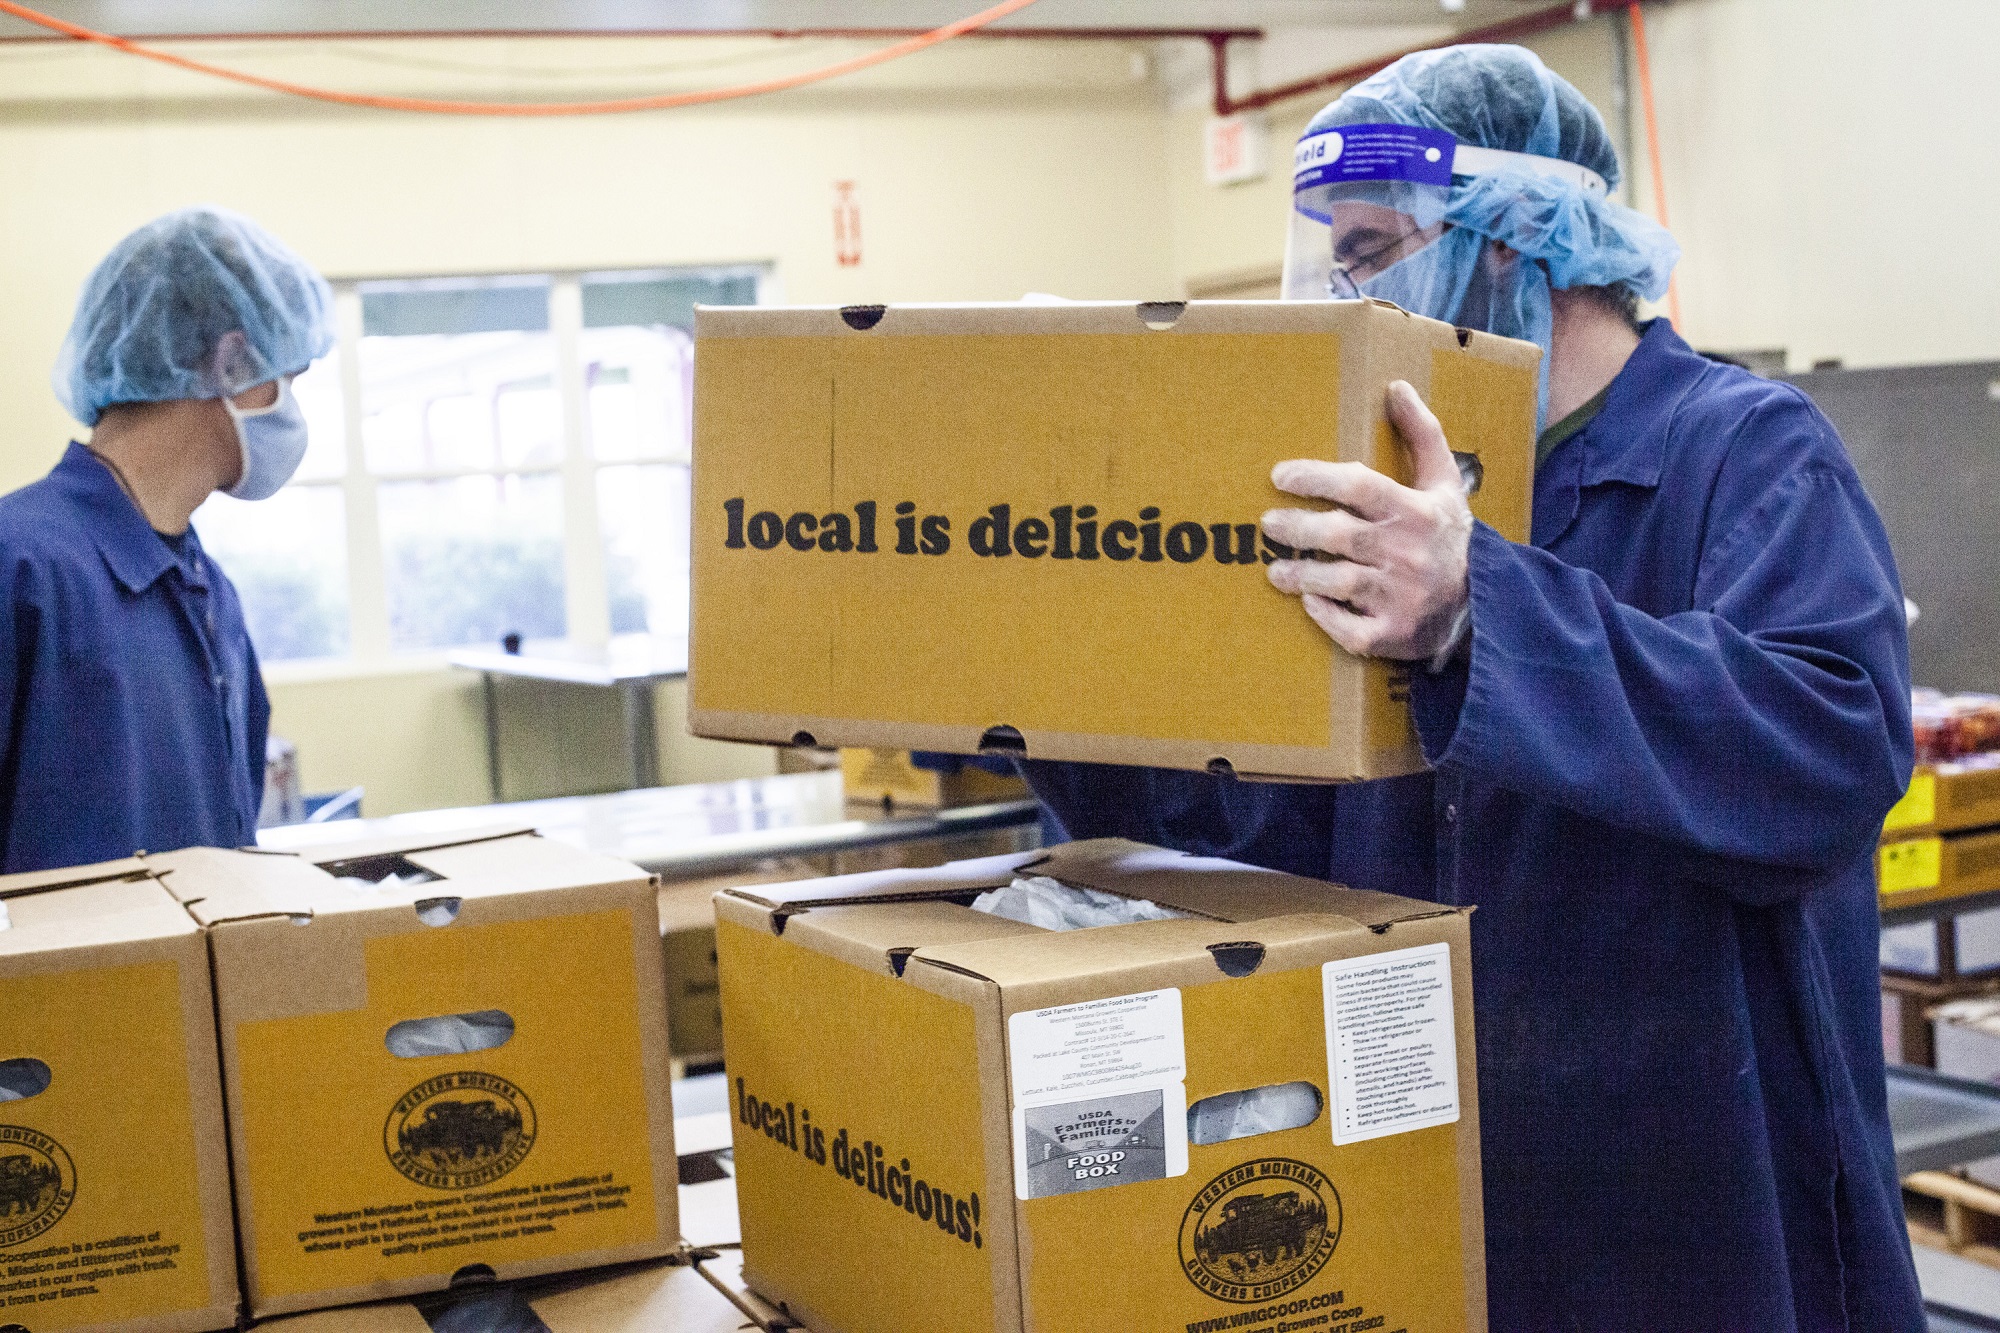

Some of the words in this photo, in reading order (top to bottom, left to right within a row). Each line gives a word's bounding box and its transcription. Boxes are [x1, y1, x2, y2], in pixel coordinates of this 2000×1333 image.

[724, 497, 878, 554] local
[895, 501, 951, 556] is
[968, 504, 1315, 566] deliciou
[1353, 967, 1388, 978] Handling
[1390, 959, 1435, 971] Instructions
[1371, 975, 1398, 984] products
[1374, 991, 1398, 999] product
[1406, 983, 1442, 993] mishandled
[1053, 1006, 1076, 1014] Farmers
[1085, 1001, 1107, 1009] Families
[1135, 993, 1158, 1003] Program
[1344, 1004, 1367, 1012] cooked
[1338, 1022, 1364, 1030] handling
[1369, 1022, 1406, 1033] refrigerated
[1378, 1029, 1414, 1040] refrigerator
[1410, 1042, 1431, 1050] poultry
[1354, 1060, 1381, 1069] separate
[1374, 1065, 1398, 1074] working
[1400, 1060, 1425, 1068] surfaces
[1387, 1071, 1407, 1079] cutting
[1356, 1092, 1383, 1102] touching
[1078, 1110, 1112, 1120] USDA
[1358, 1115, 1392, 1127] Refrigerate
[1394, 1109, 1420, 1118] leftovers
[1430, 1103, 1452, 1111] discard
[1054, 1116, 1122, 1134] Farmers
[0, 1128, 54, 1155] ONTANA
[1058, 1126, 1129, 1143] Families
[736, 1077, 798, 1151] local
[802, 1109, 826, 1166] is
[832, 1128, 982, 1249] delicious!
[1067, 1151, 1126, 1169] FOOD
[1075, 1164, 1119, 1180] BOX
[1193, 1165, 1255, 1213] WESTERN
[1260, 1162, 1323, 1191] MONTANA
[0, 1245, 69, 1264] Cooperative
[71, 1243, 82, 1252] is
[94, 1235, 144, 1249] coalition
[147, 1232, 160, 1242] of
[1187, 1259, 1247, 1299] GROWERS
[1253, 1230, 1337, 1298] COOPERATIVE
[1186, 1290, 1344, 1333] WWW.WMGCOOP.COM
[1277, 1314, 1329, 1333] Growers
[1332, 1306, 1363, 1321] Coop
